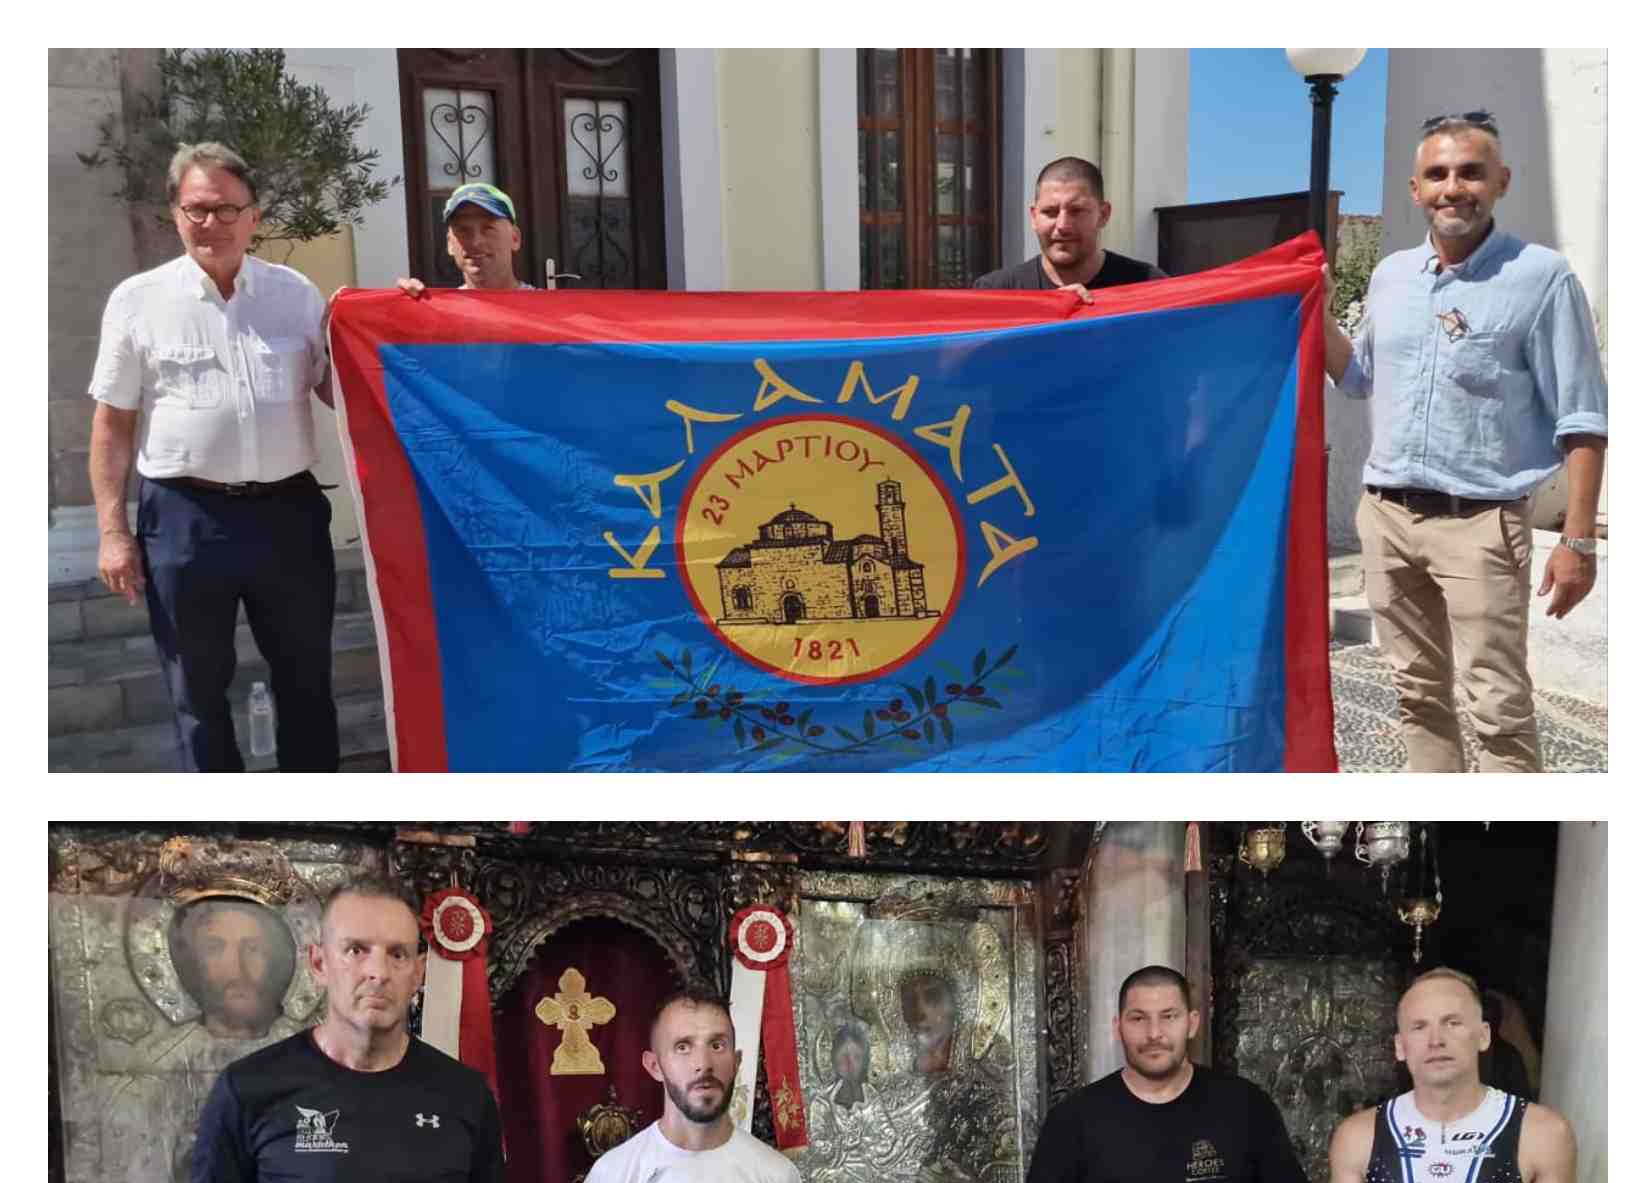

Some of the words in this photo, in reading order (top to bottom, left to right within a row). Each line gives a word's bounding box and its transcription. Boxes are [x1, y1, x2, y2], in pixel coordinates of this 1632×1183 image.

[602, 357, 1040, 589] ΚΑΛΑΜΑΤΑ
[702, 493, 731, 527] 23
[724, 433, 885, 490] ΜΑΡΤΙΟΥ
[792, 636, 862, 663] 1821
